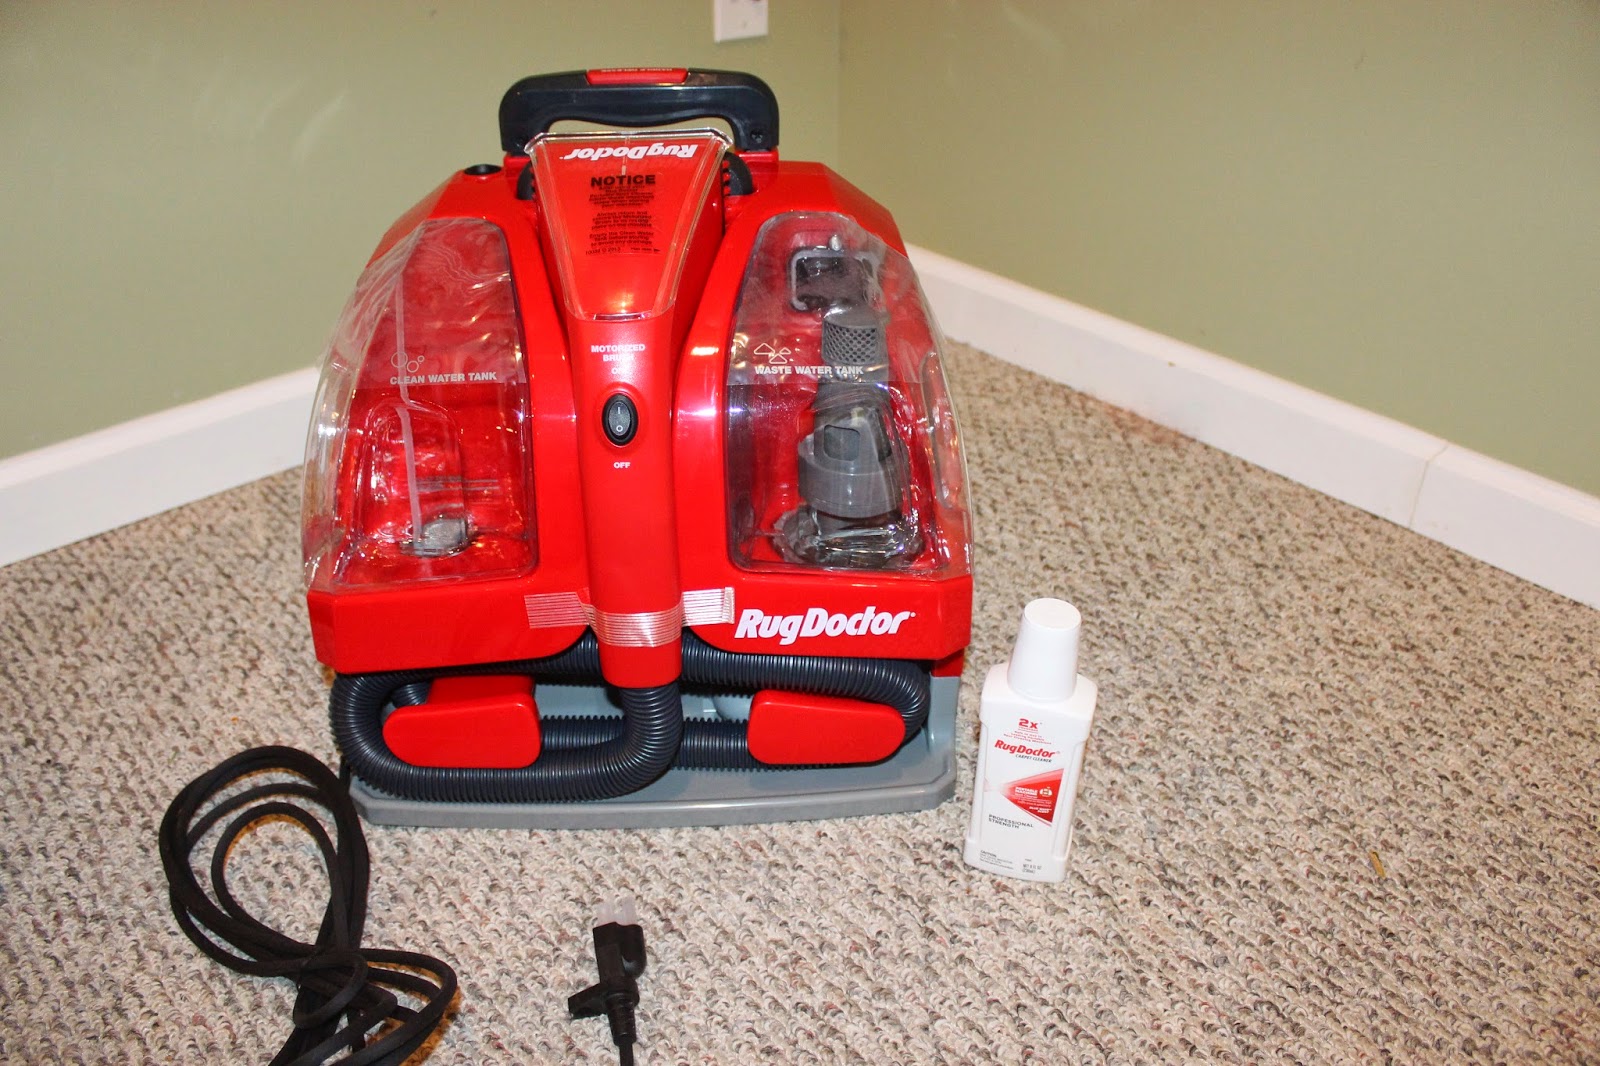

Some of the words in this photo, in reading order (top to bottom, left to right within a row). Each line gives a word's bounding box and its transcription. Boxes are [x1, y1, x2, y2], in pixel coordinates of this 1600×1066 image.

[563, 142, 698, 161] RugDoctor
[591, 174, 656, 188] NOTICE
[591, 344, 646, 353] MOTORIZED
[603, 354, 634, 362] BRUH
[754, 366, 792, 375] WASTE
[795, 366, 832, 374] WATER
[835, 366, 864, 375] TANK
[390, 376, 425, 385] CLEAN
[428, 373, 465, 383] WATER
[468, 371, 497, 381] TANK
[734, 606, 910, 646] RugDoctor
[994, 739, 1056, 758] RugDoctor
[988, 814, 1034, 828] PROFESSIONAL
[988, 818, 1019, 829] STRENGTH
